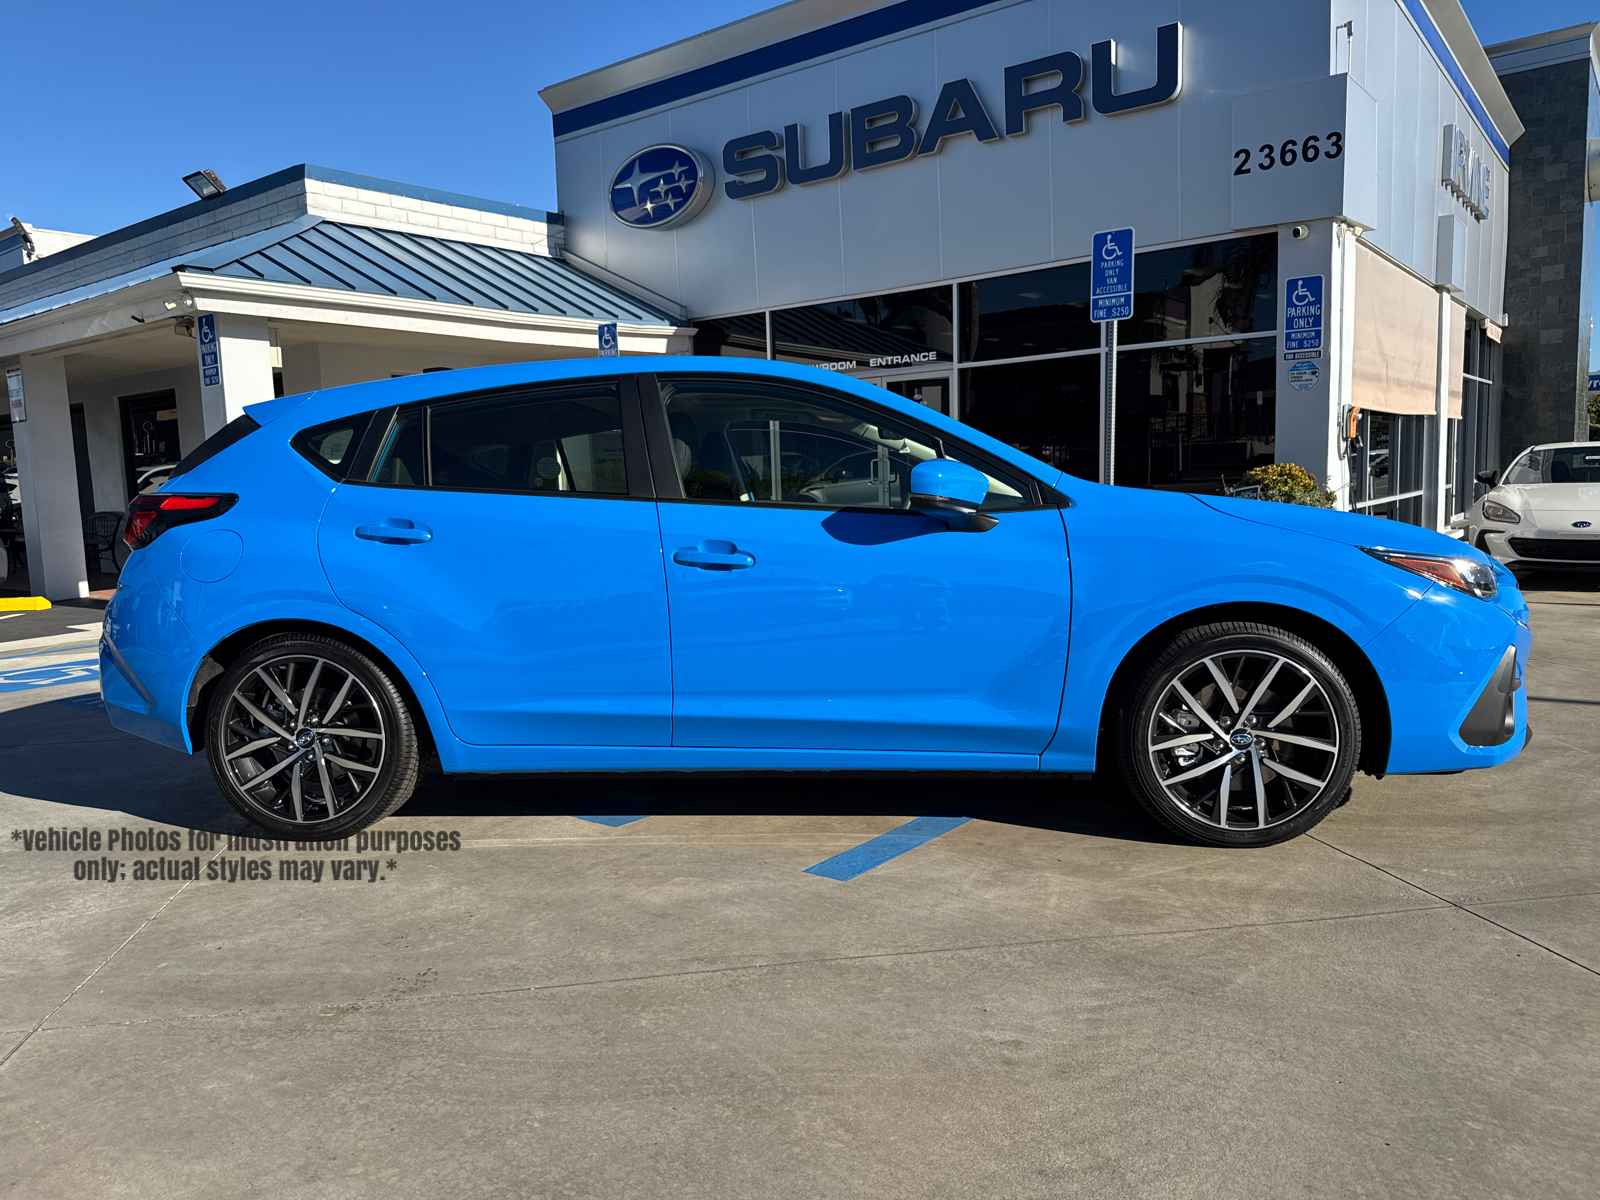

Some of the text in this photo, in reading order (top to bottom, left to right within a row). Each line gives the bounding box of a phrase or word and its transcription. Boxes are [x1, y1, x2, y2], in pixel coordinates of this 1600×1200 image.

[722, 21, 1184, 201] SUBARU
[1233, 131, 1342, 176] 23663
[1101, 259, 1124, 269] PARKING
[1105, 268, 1119, 277] ONLY
[1096, 283, 1128, 294] ACCESSIBLE
[1098, 296, 1125, 308] MINIMUM
[1094, 306, 1129, 319] FINE $250
[1287, 304, 1320, 318] PARKING
[1294, 317, 1314, 328] ONLY
[1291, 331, 1315, 340] MINIMUM
[201, 341, 217, 354] PARKING
[1286, 340, 1319, 348] FINE $250
[600, 347, 618, 358] PARKING
[204, 354, 215, 366] ONLY
[869, 351, 937, 367] ENTRANCE
